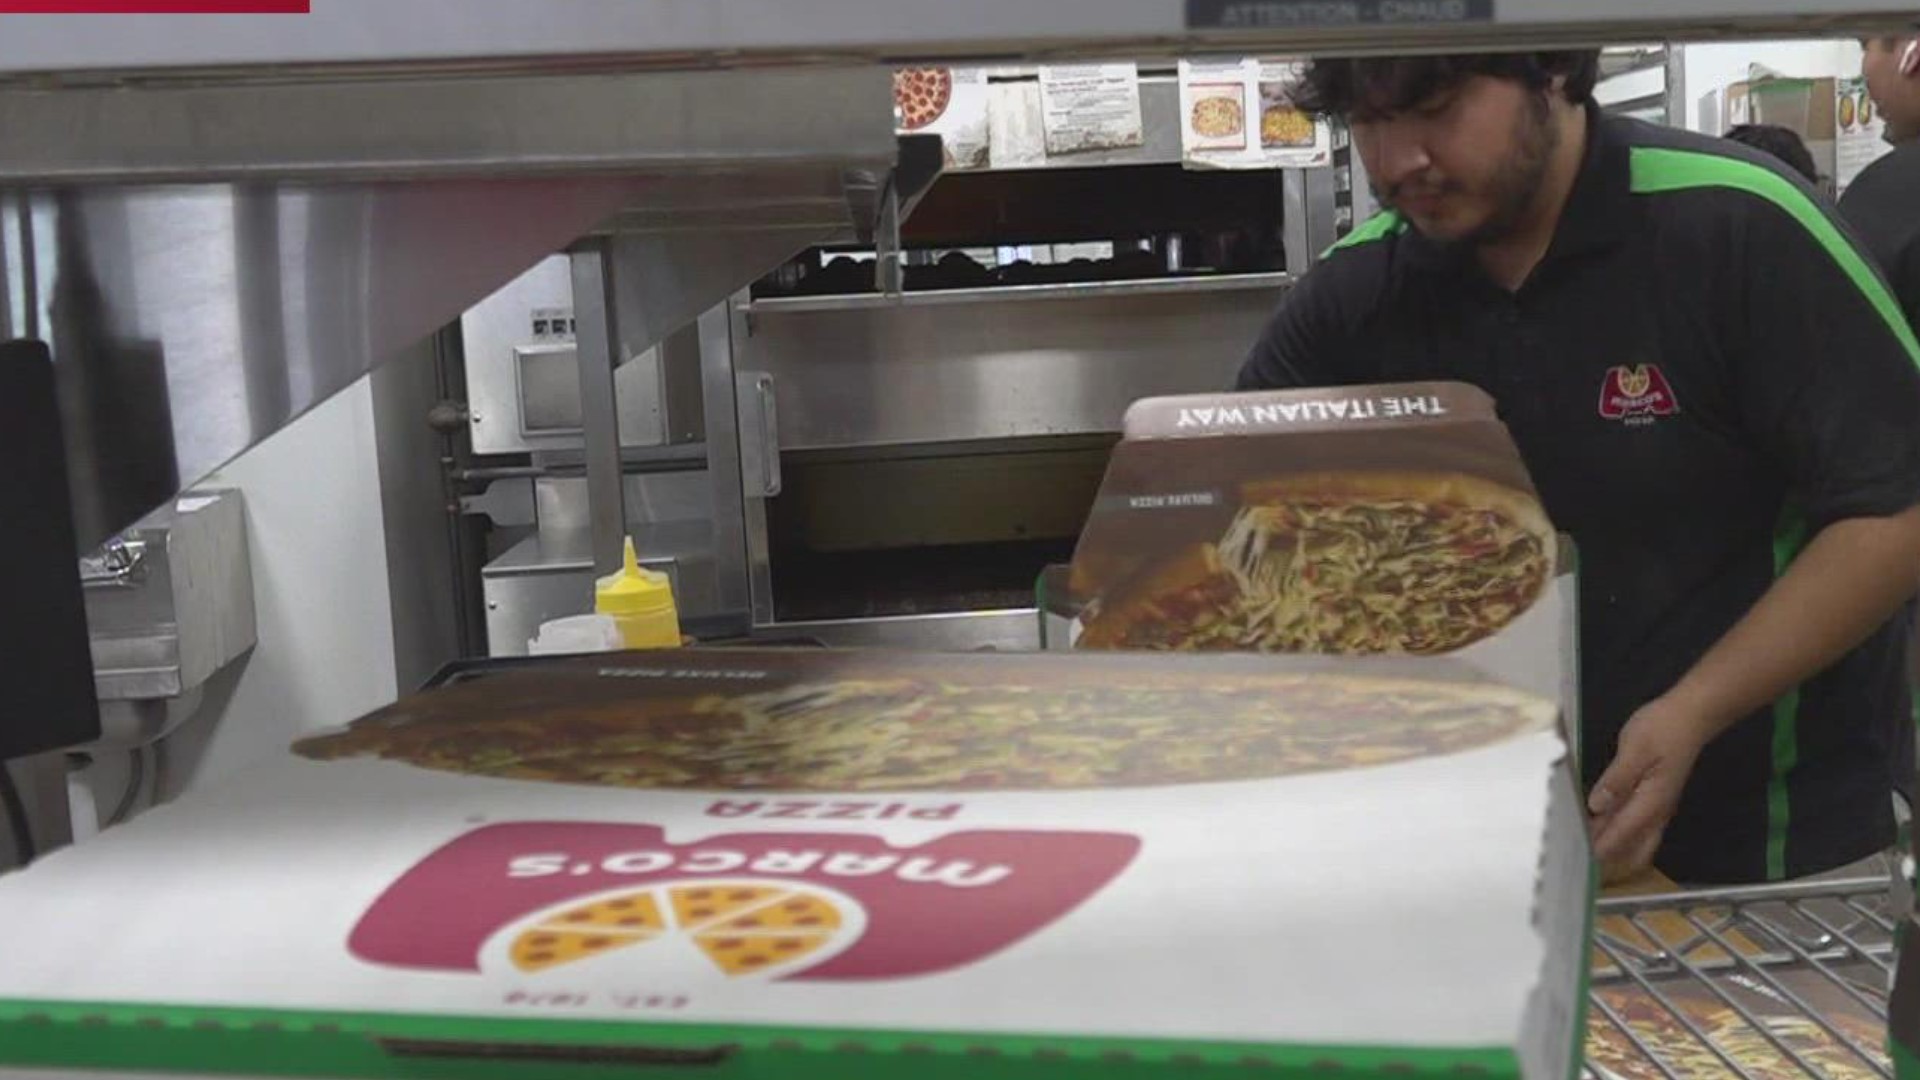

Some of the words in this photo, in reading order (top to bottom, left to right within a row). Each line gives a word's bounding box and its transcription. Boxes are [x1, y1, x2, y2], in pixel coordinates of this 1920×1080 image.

[1221, 3, 1356, 26] ATTENTION
[1378, 1, 1466, 23] CHAUD
[1176, 407, 1248, 428] WAY
[1253, 398, 1376, 425] ITALIAN
[1382, 396, 1447, 416] THE
[705, 800, 963, 821] PIZZA
[507, 849, 1013, 888] MARCO'S
